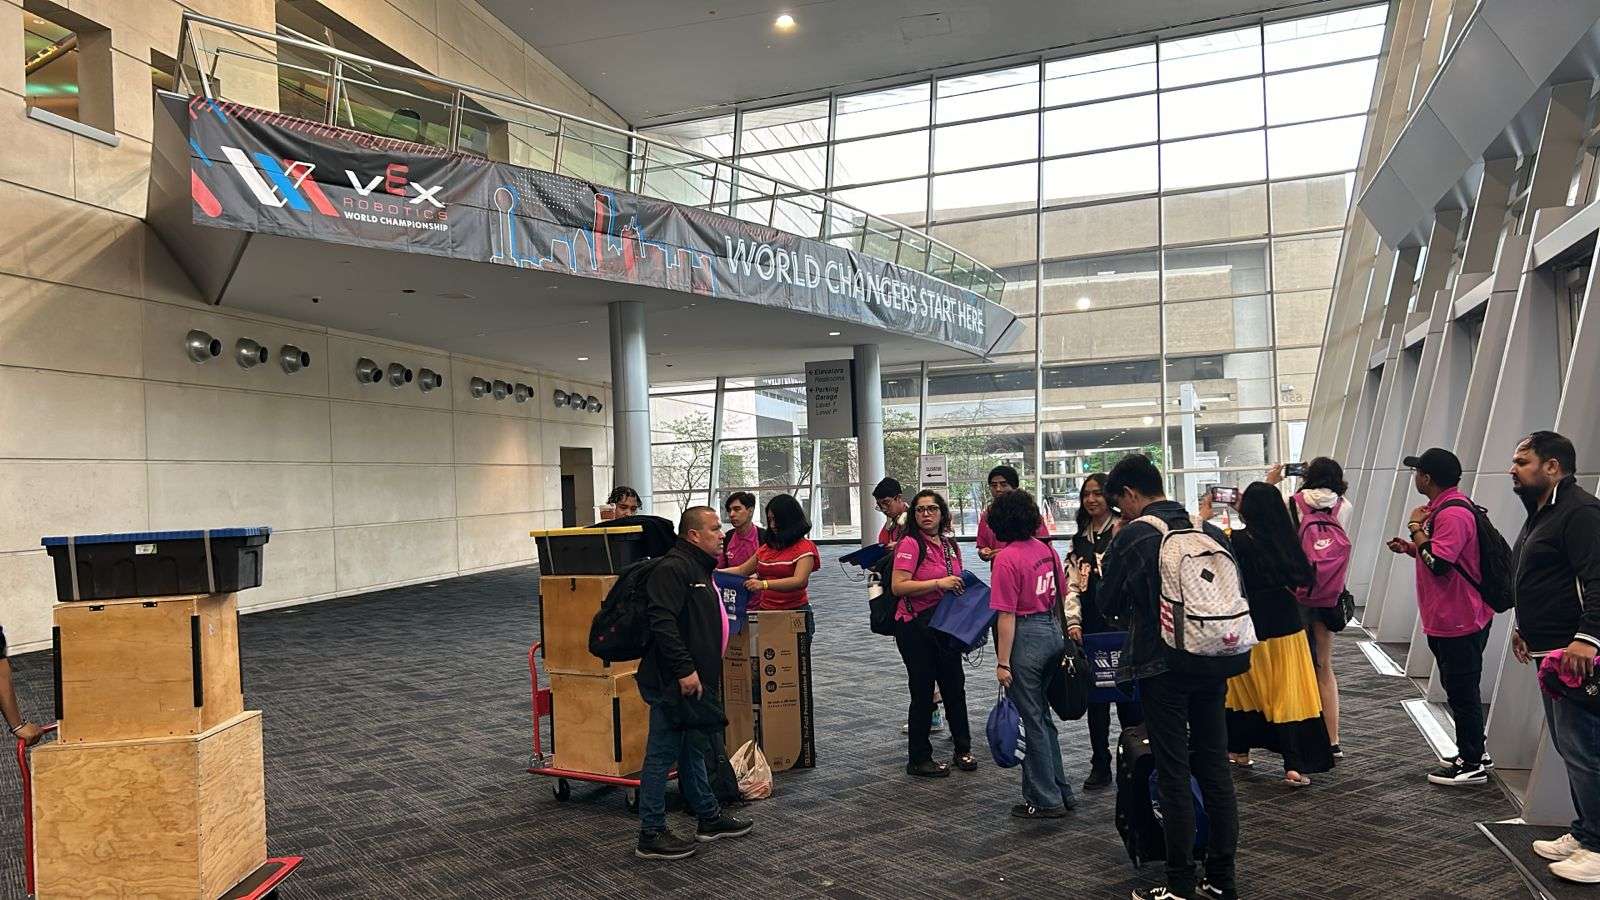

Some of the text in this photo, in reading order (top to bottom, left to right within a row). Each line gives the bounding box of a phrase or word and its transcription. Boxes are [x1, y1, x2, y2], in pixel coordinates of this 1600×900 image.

[344, 162, 446, 208] VEX
[343, 197, 448, 221] ROBOTICS
[344, 211, 378, 223] WORLD
[725, 235, 984, 335] WORLD CHANGERS START HERE
[815, 386, 839, 394] Parking
